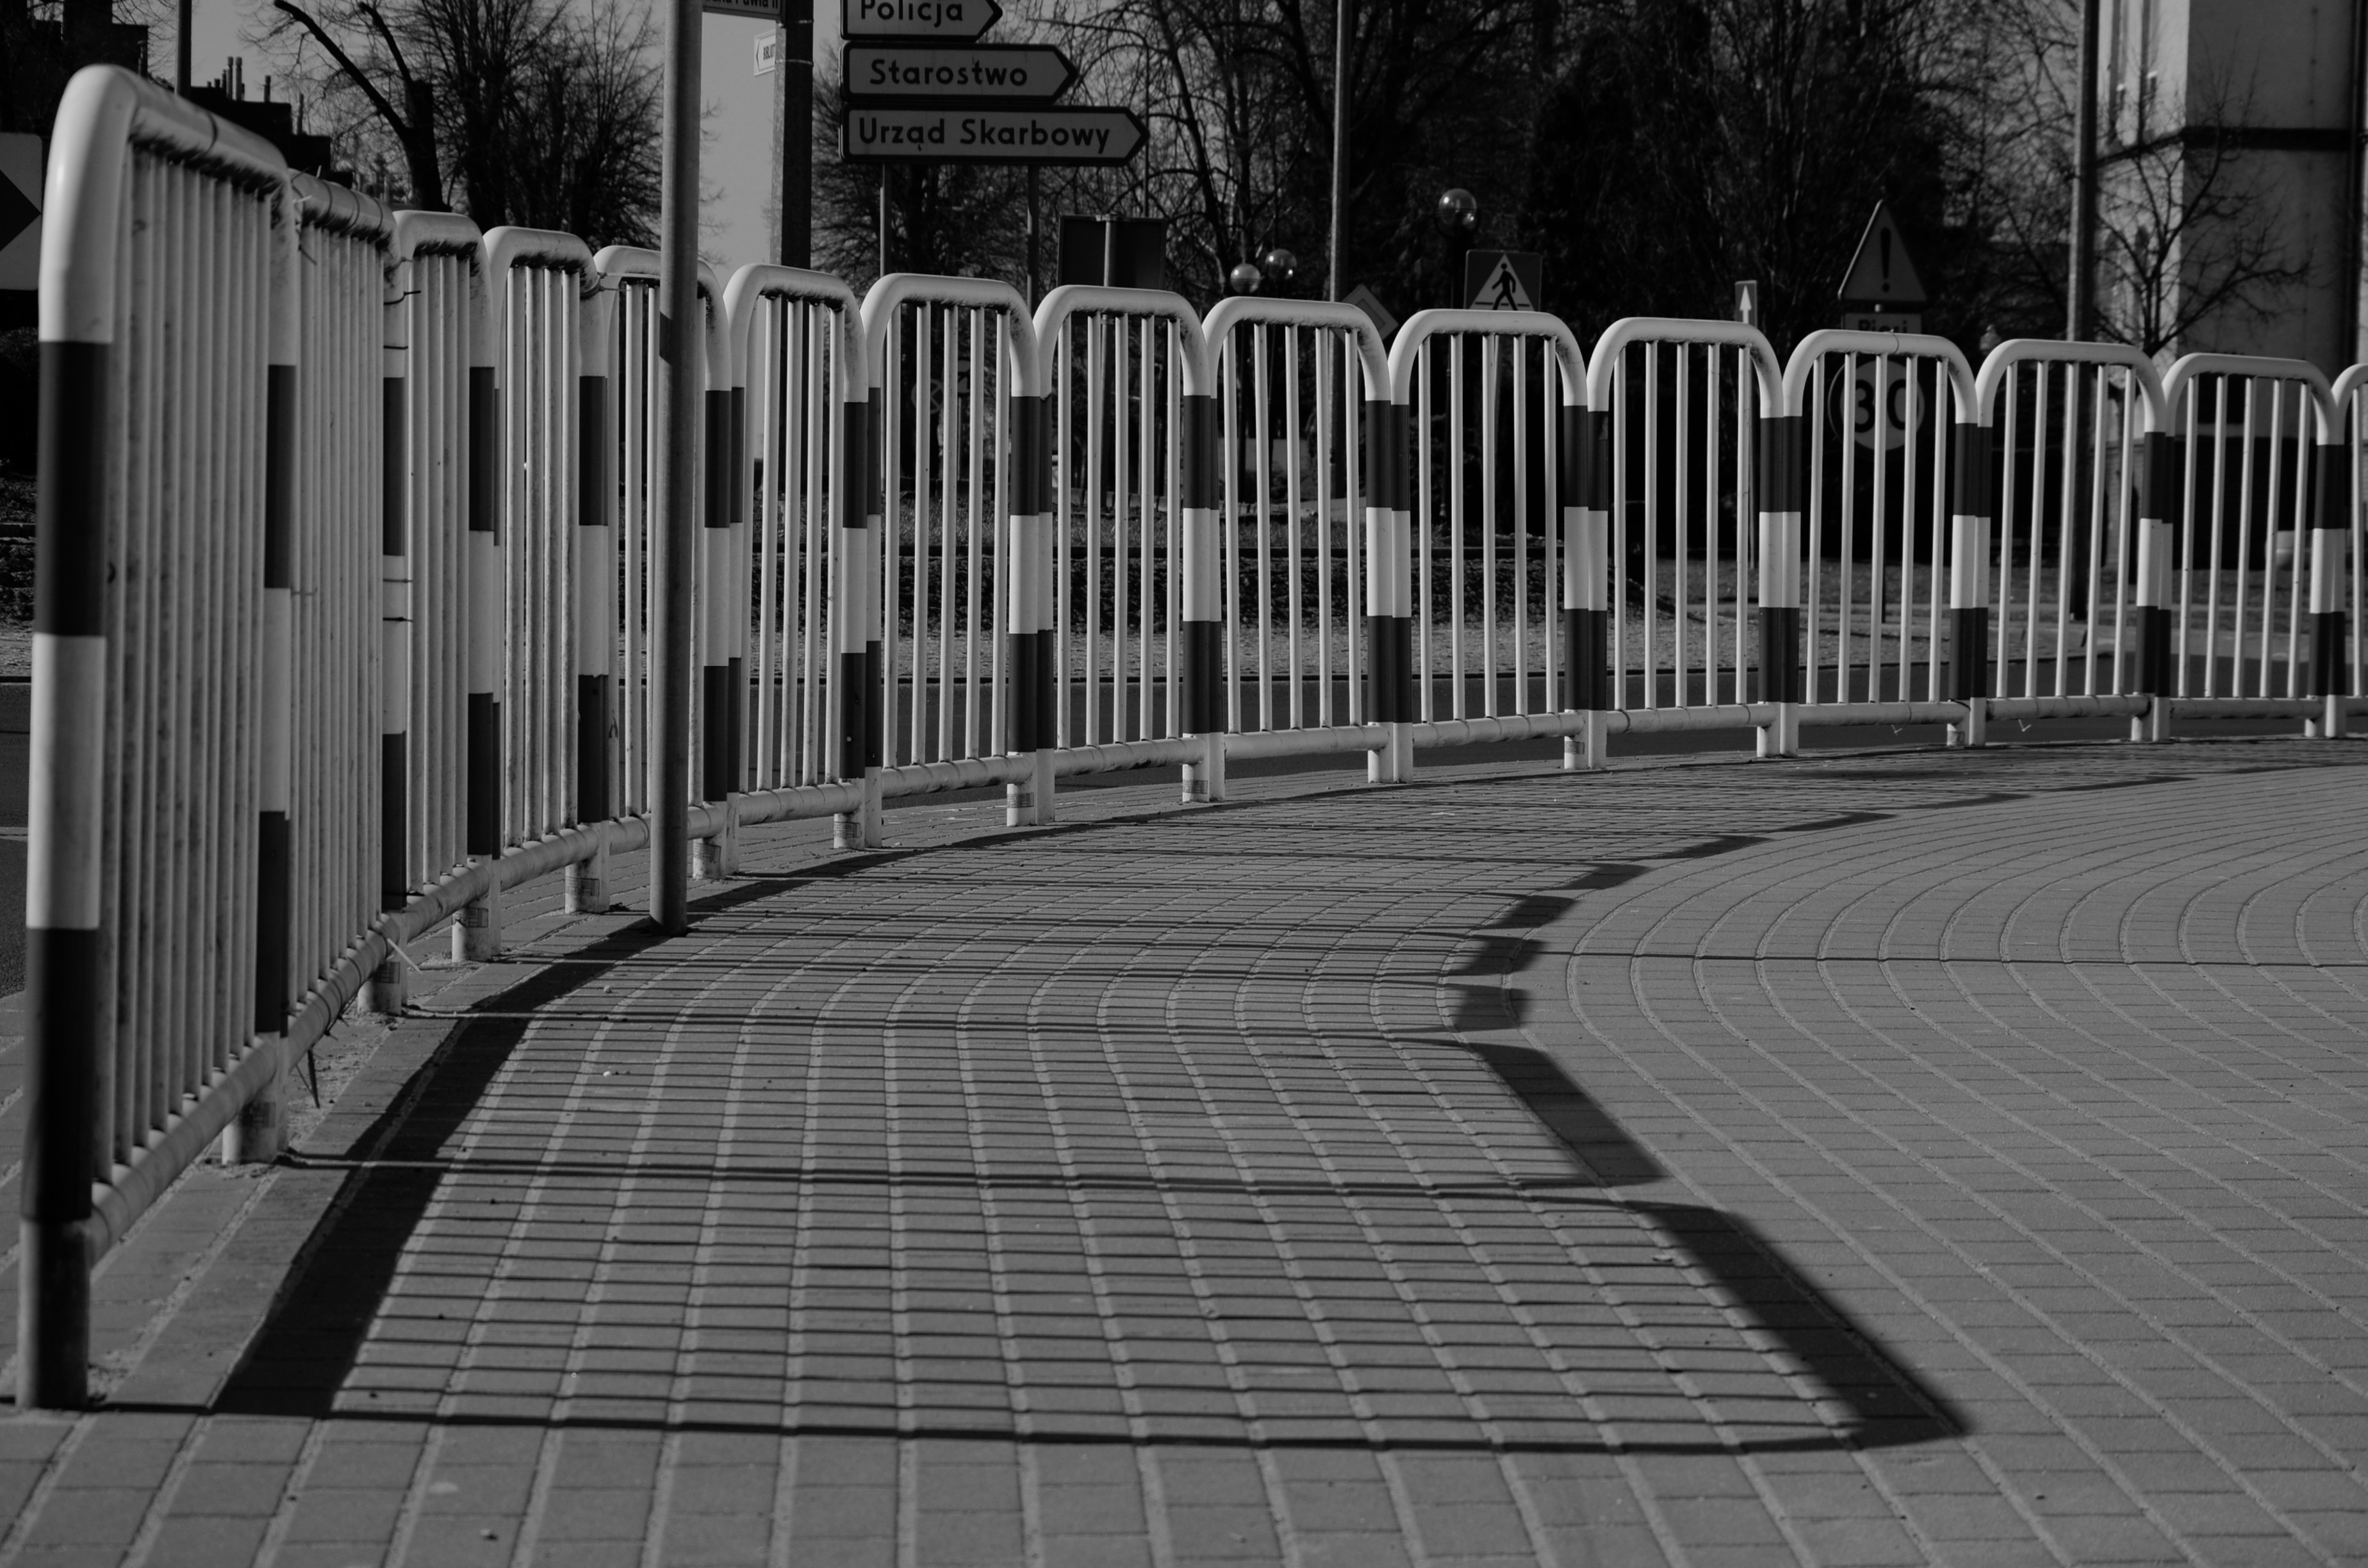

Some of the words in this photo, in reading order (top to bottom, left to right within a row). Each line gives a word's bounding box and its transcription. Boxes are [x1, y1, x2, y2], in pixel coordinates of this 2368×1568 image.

[861, 0, 963, 28] Policja
[870, 59, 1028, 86] Starostwo
[859, 117, 945, 151] Urząd
[960, 119, 1110, 154] Skarbowy
[1849, 379, 1919, 432] 30
